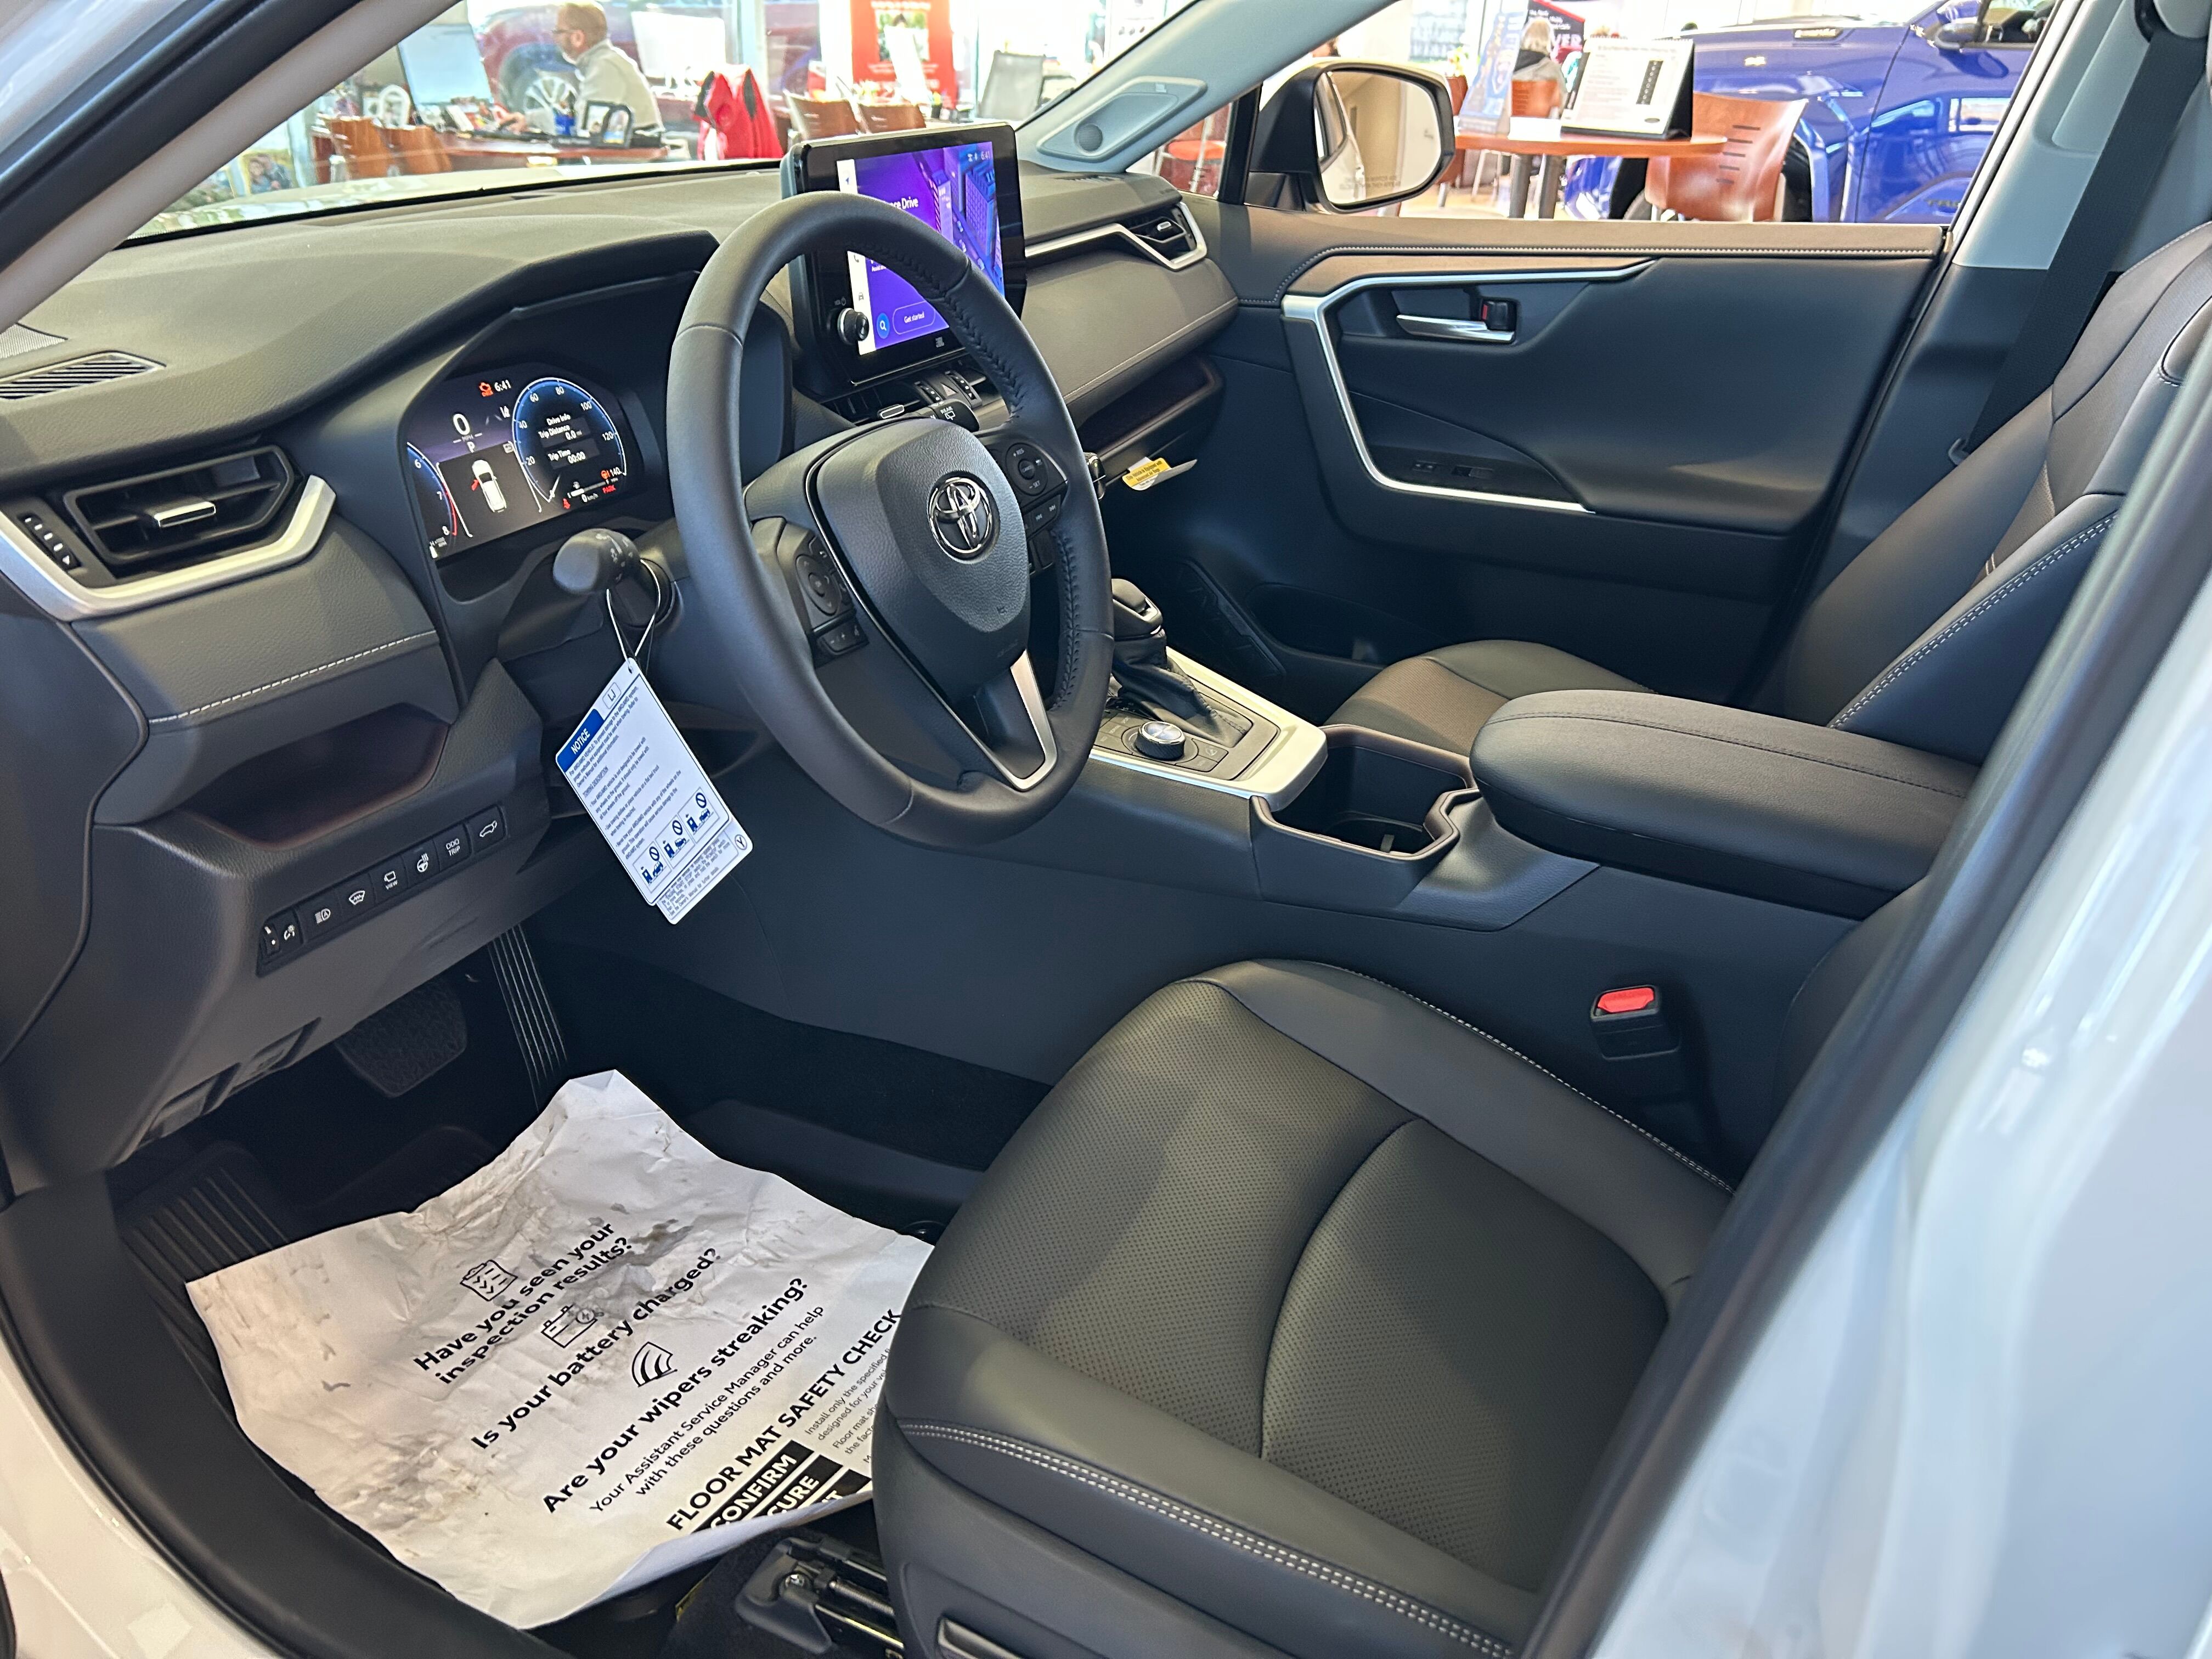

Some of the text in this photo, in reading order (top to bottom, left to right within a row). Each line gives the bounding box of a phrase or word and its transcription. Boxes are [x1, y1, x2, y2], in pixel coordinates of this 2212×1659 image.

[901, 196, 918, 210] Drive
[904, 311, 925, 324] Get started
[494, 380, 511, 392] 6:41
[555, 386, 565, 395] 80
[529, 393, 539, 403] 60
[580, 401, 592, 411] 100
[940, 406, 953, 414] REAR
[453, 413, 470, 436] 0
[519, 420, 528, 429] 40
[546, 413, 571, 426] Drive Info
[538, 425, 570, 439] Trip Distance
[565, 430, 576, 440] 0.0
[602, 431, 614, 441] 120
[467, 442, 475, 453] P
[526, 456, 535, 465] 20
[548, 449, 571, 461] Trip Time
[567, 452, 585, 464] 00:00
[414, 459, 422, 469] 6
[610, 467, 622, 476] 140
[437, 491, 442, 500] 7
[442, 526, 449, 535] 8
[607, 689, 617, 702] LJ
[570, 727, 591, 755] NOTICE
[445, 838, 460, 850] ODO
[448, 845, 461, 856] TRIP
[385, 879, 398, 890] VIEW
[413, 1223, 615, 1370] Have you seen your
[435, 1237, 632, 1385] inspection results?
[471, 1248, 721, 1449] Is your battery charged?
[542, 1278, 808, 1514] Are your wipers streaking?
[804, 1412, 831, 1435] Install
[828, 1397, 847, 1414] only
[842, 1385, 858, 1398] the
[856, 1353, 888, 1385] specified
[589, 1305, 825, 1513] Your Assistant Service Manager can help
[817, 1406, 852, 1441] designed
[849, 1397, 863, 1409] for
[861, 1380, 878, 1399] your
[635, 1335, 818, 1496] with these questions and more.
[665, 1308, 902, 1532] FLOOR MAT SAFETY CHECK
[832, 1415, 870, 1449] Floor mat
[844, 1441, 860, 1455] the
